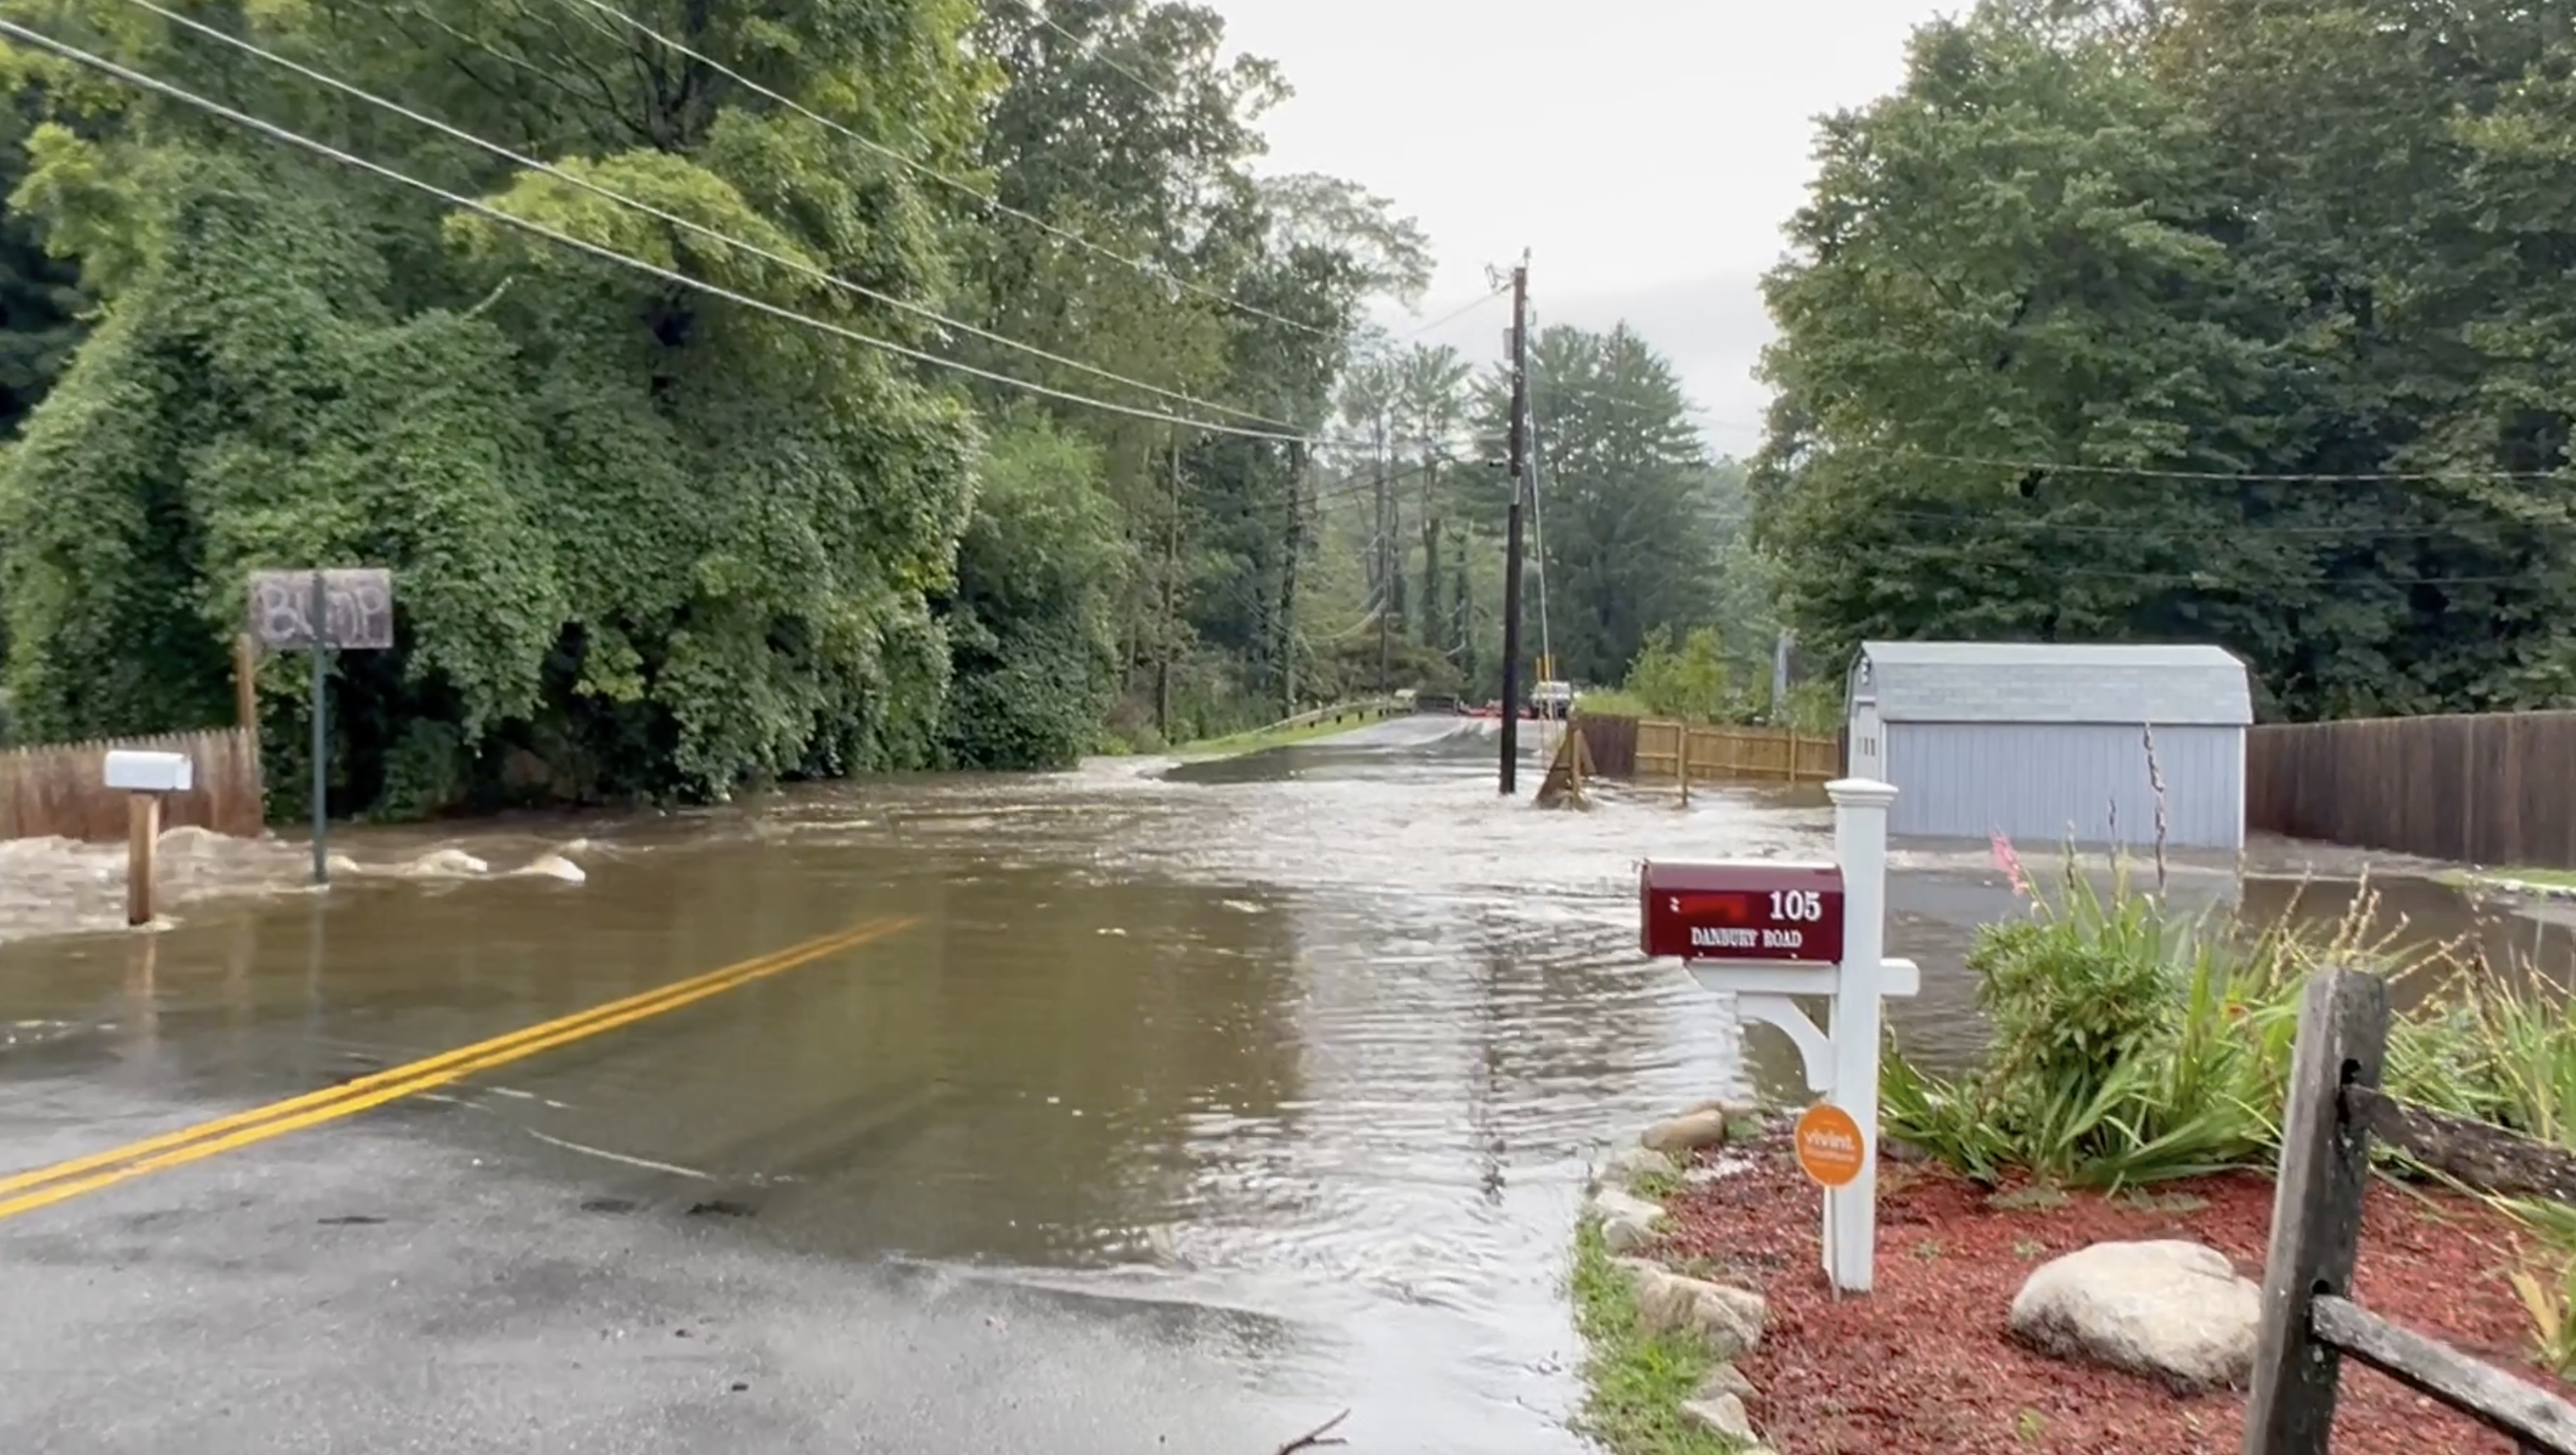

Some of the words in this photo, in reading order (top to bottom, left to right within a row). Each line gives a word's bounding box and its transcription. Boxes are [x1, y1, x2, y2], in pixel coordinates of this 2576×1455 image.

[1769, 890, 1822, 921] 105
[1690, 926, 1759, 947] DANBURY
[1762, 928, 1803, 948] ROAD
